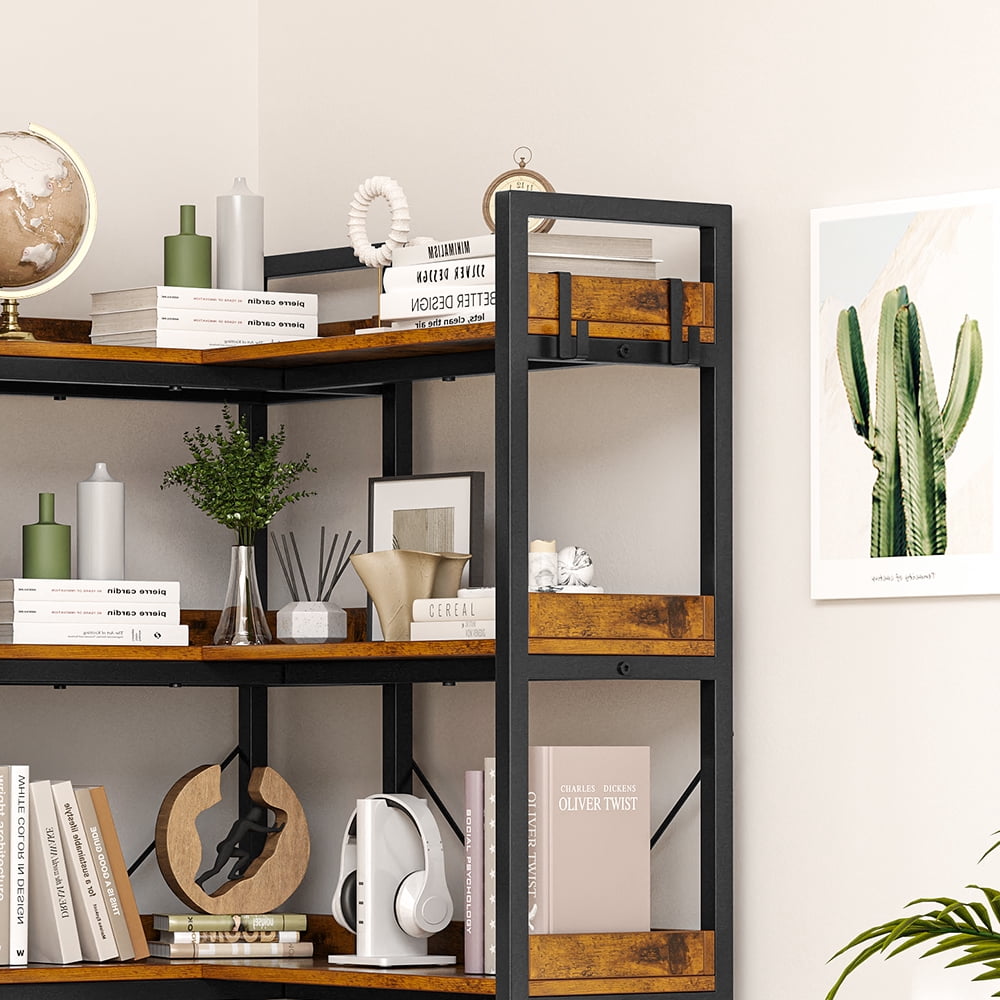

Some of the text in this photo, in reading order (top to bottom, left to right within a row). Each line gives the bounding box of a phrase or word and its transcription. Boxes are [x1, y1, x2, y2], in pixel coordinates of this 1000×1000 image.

[429, 602, 476, 618] CEREAL
[560, 784, 637, 793] CHARLES DICKENS
[558, 796, 638, 811] OLIVER TWIST
[528, 791, 537, 898] OLIVER TWIST
